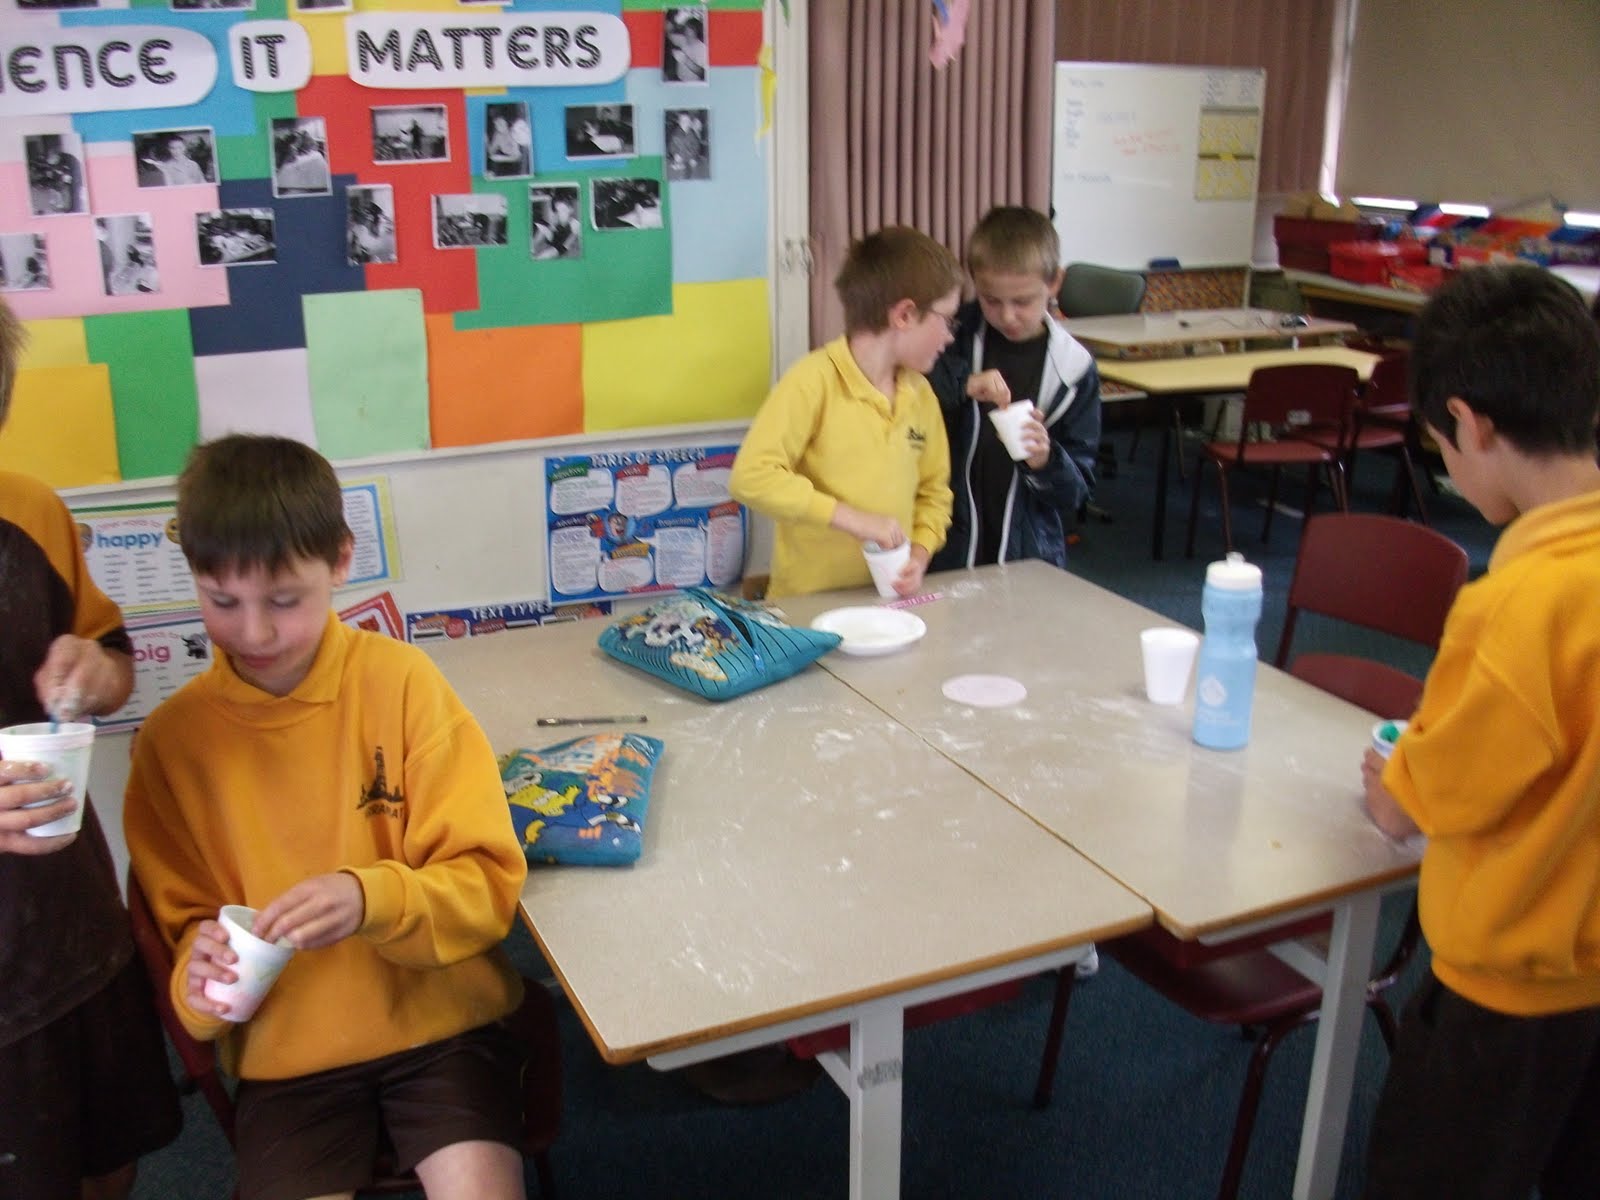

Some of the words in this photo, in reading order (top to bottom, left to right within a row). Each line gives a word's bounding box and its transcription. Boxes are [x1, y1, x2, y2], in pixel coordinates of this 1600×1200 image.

[240, 34, 286, 80] IT
[356, 24, 602, 73] MATTERS
[591, 452, 632, 468] PARTS
[635, 450, 650, 465] OF
[655, 446, 706, 463] SPEECH
[96, 532, 163, 549] happy
[469, 604, 505, 620] TEXT
